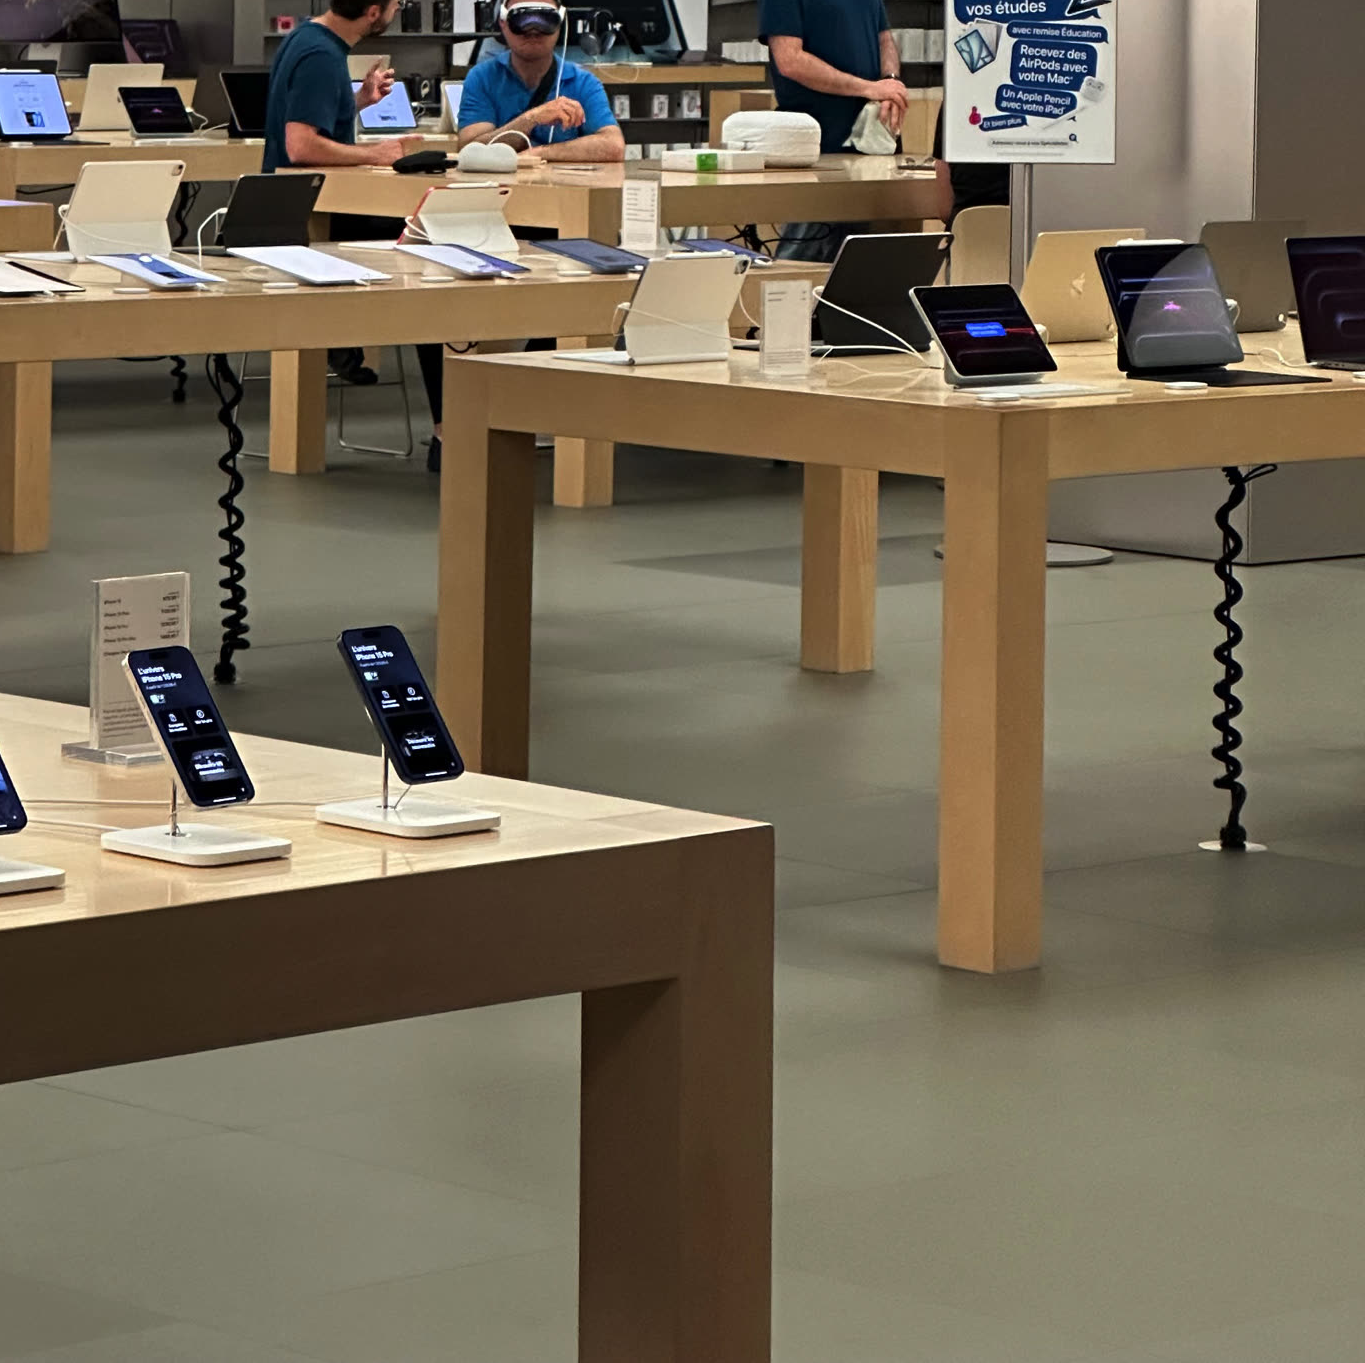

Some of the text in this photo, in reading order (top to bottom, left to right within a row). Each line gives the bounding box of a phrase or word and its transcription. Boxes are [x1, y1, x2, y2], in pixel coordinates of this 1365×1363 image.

[966, 0, 1047, 16] vos études
[1012, 26, 1102, 38] avec remise Éducation
[1020, 44, 1087, 60] Recevez des
[1019, 57, 1088, 73] AirPods avec
[1018, 71, 1045, 82] votre
[1002, 88, 1071, 105] Un Apple Pencil
[1000, 100, 1021, 109] avec
[1022, 102, 1043, 112] votre
